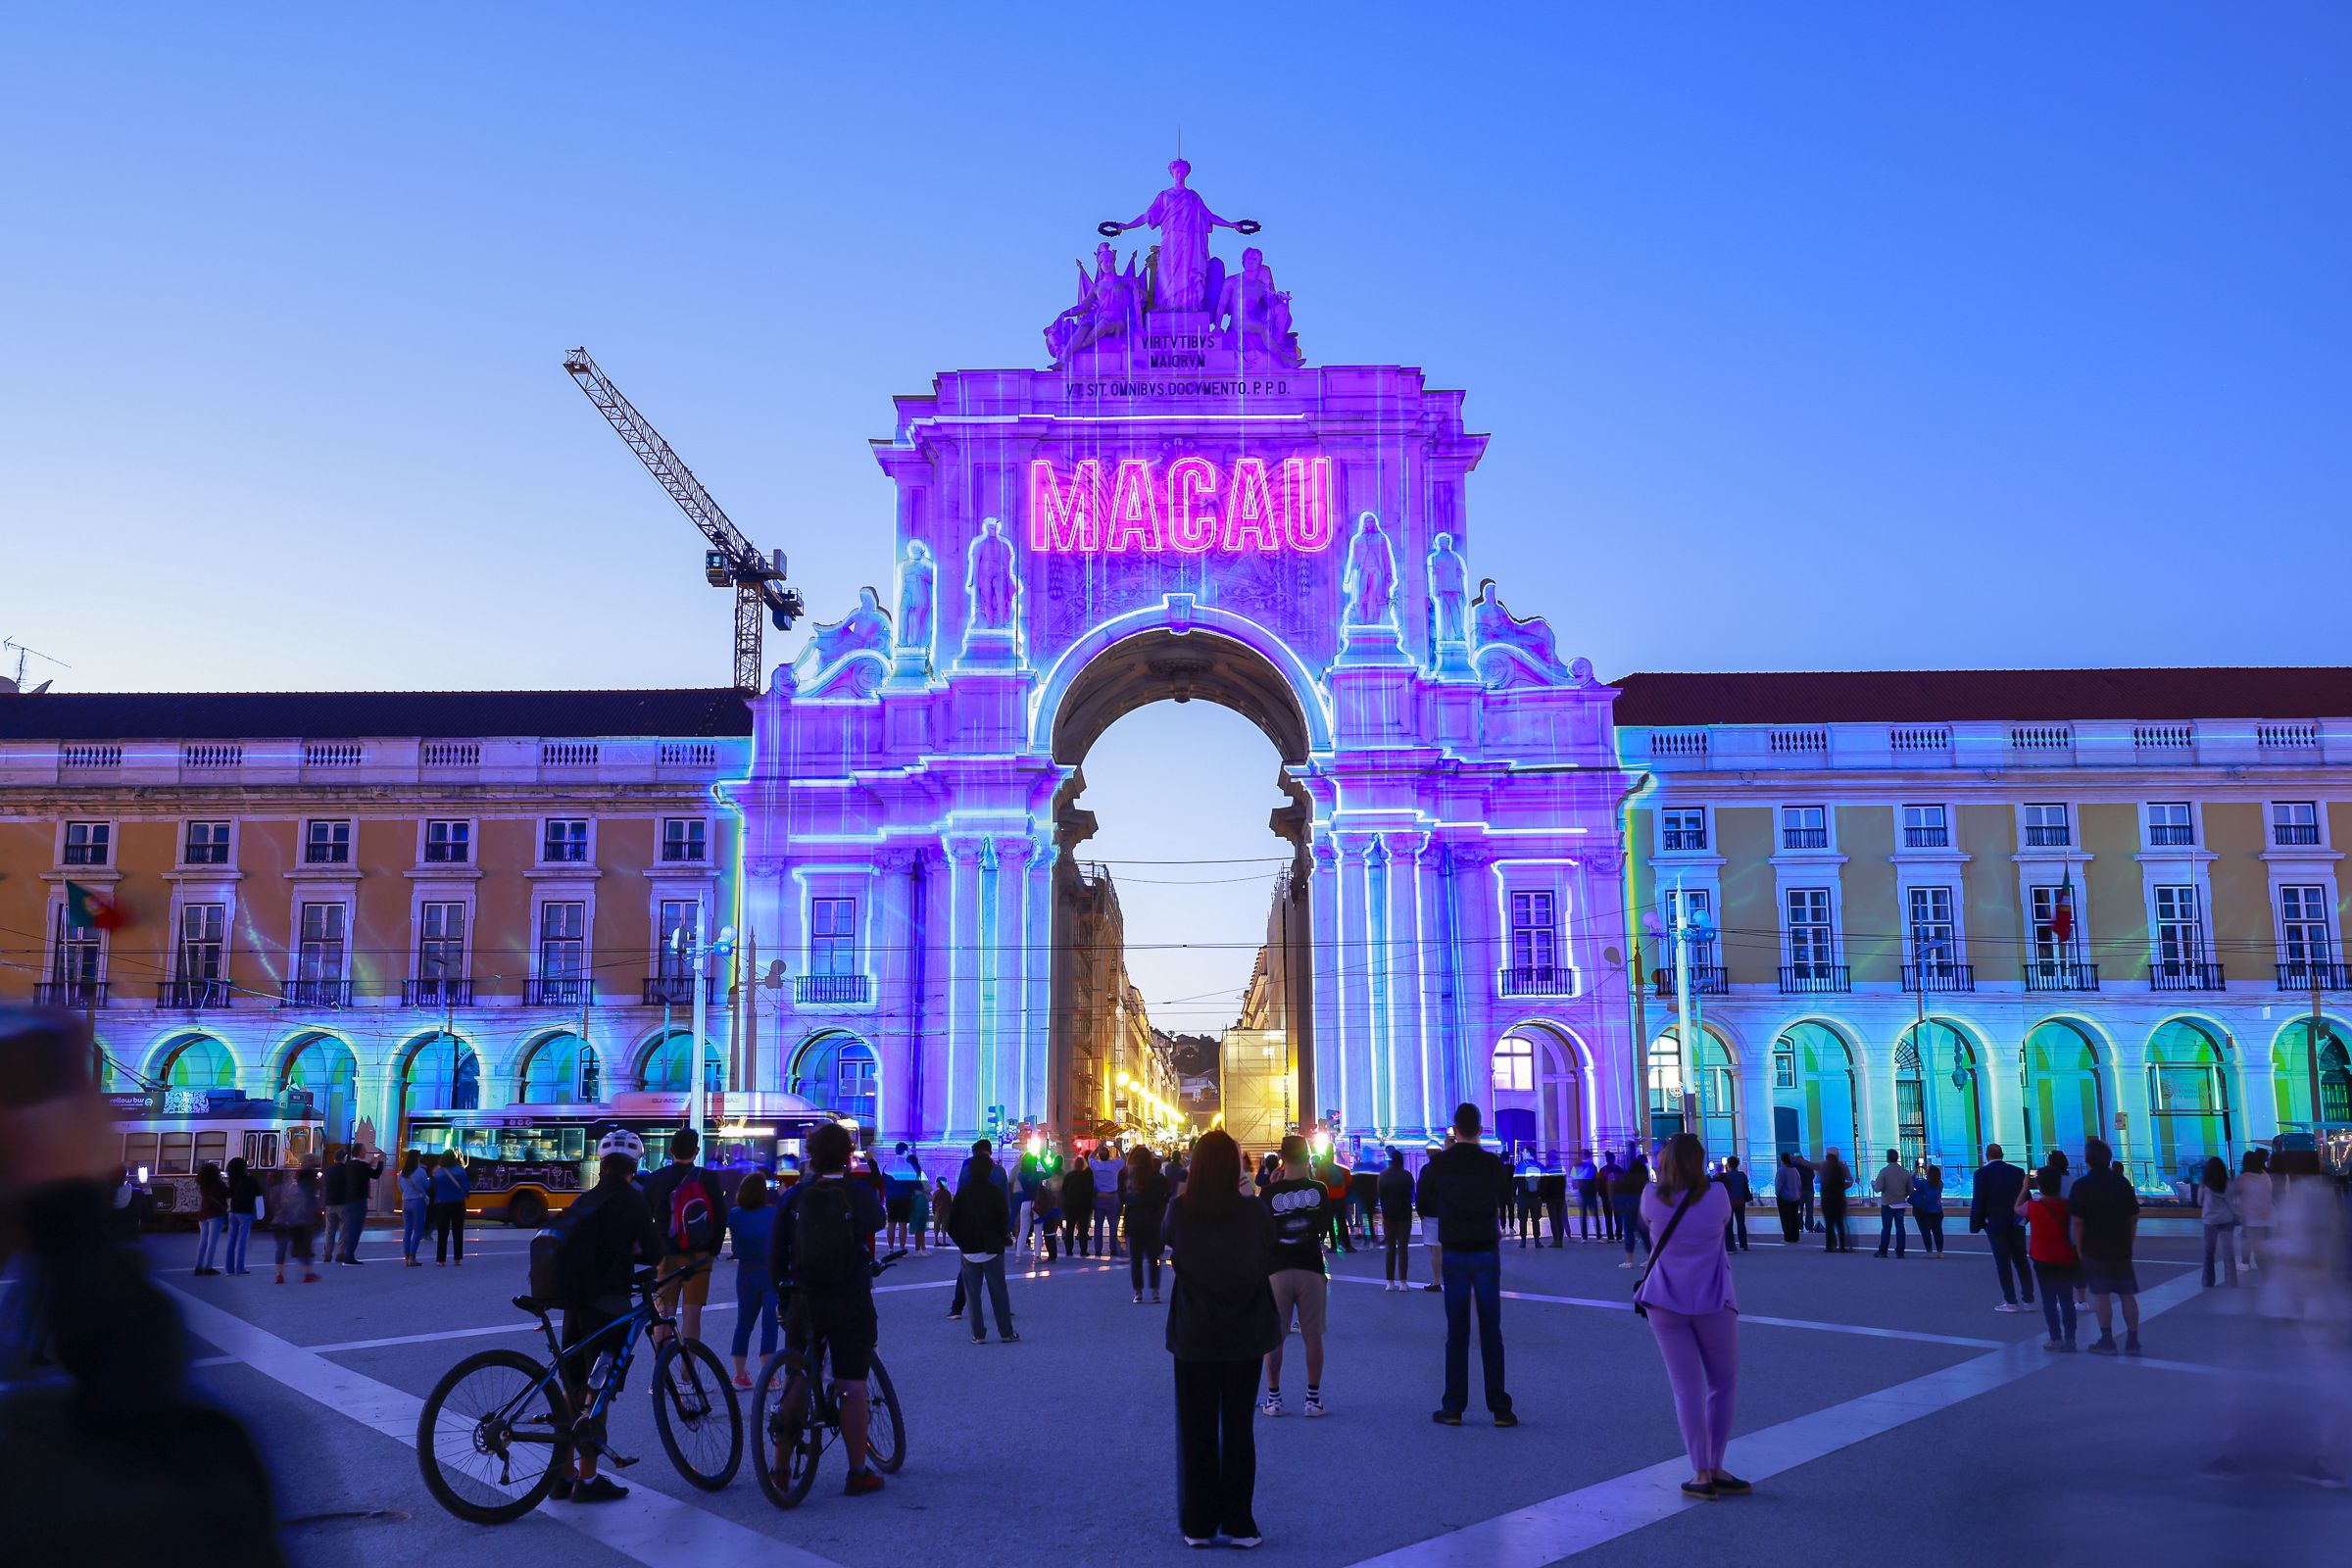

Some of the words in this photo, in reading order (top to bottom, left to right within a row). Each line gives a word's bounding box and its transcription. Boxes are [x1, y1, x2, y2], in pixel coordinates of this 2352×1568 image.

[1141, 335, 1215, 350] VIRTVTIBVS
[1150, 354, 1206, 368] MAIORVM
[1031, 457, 1333, 553] MACAU
